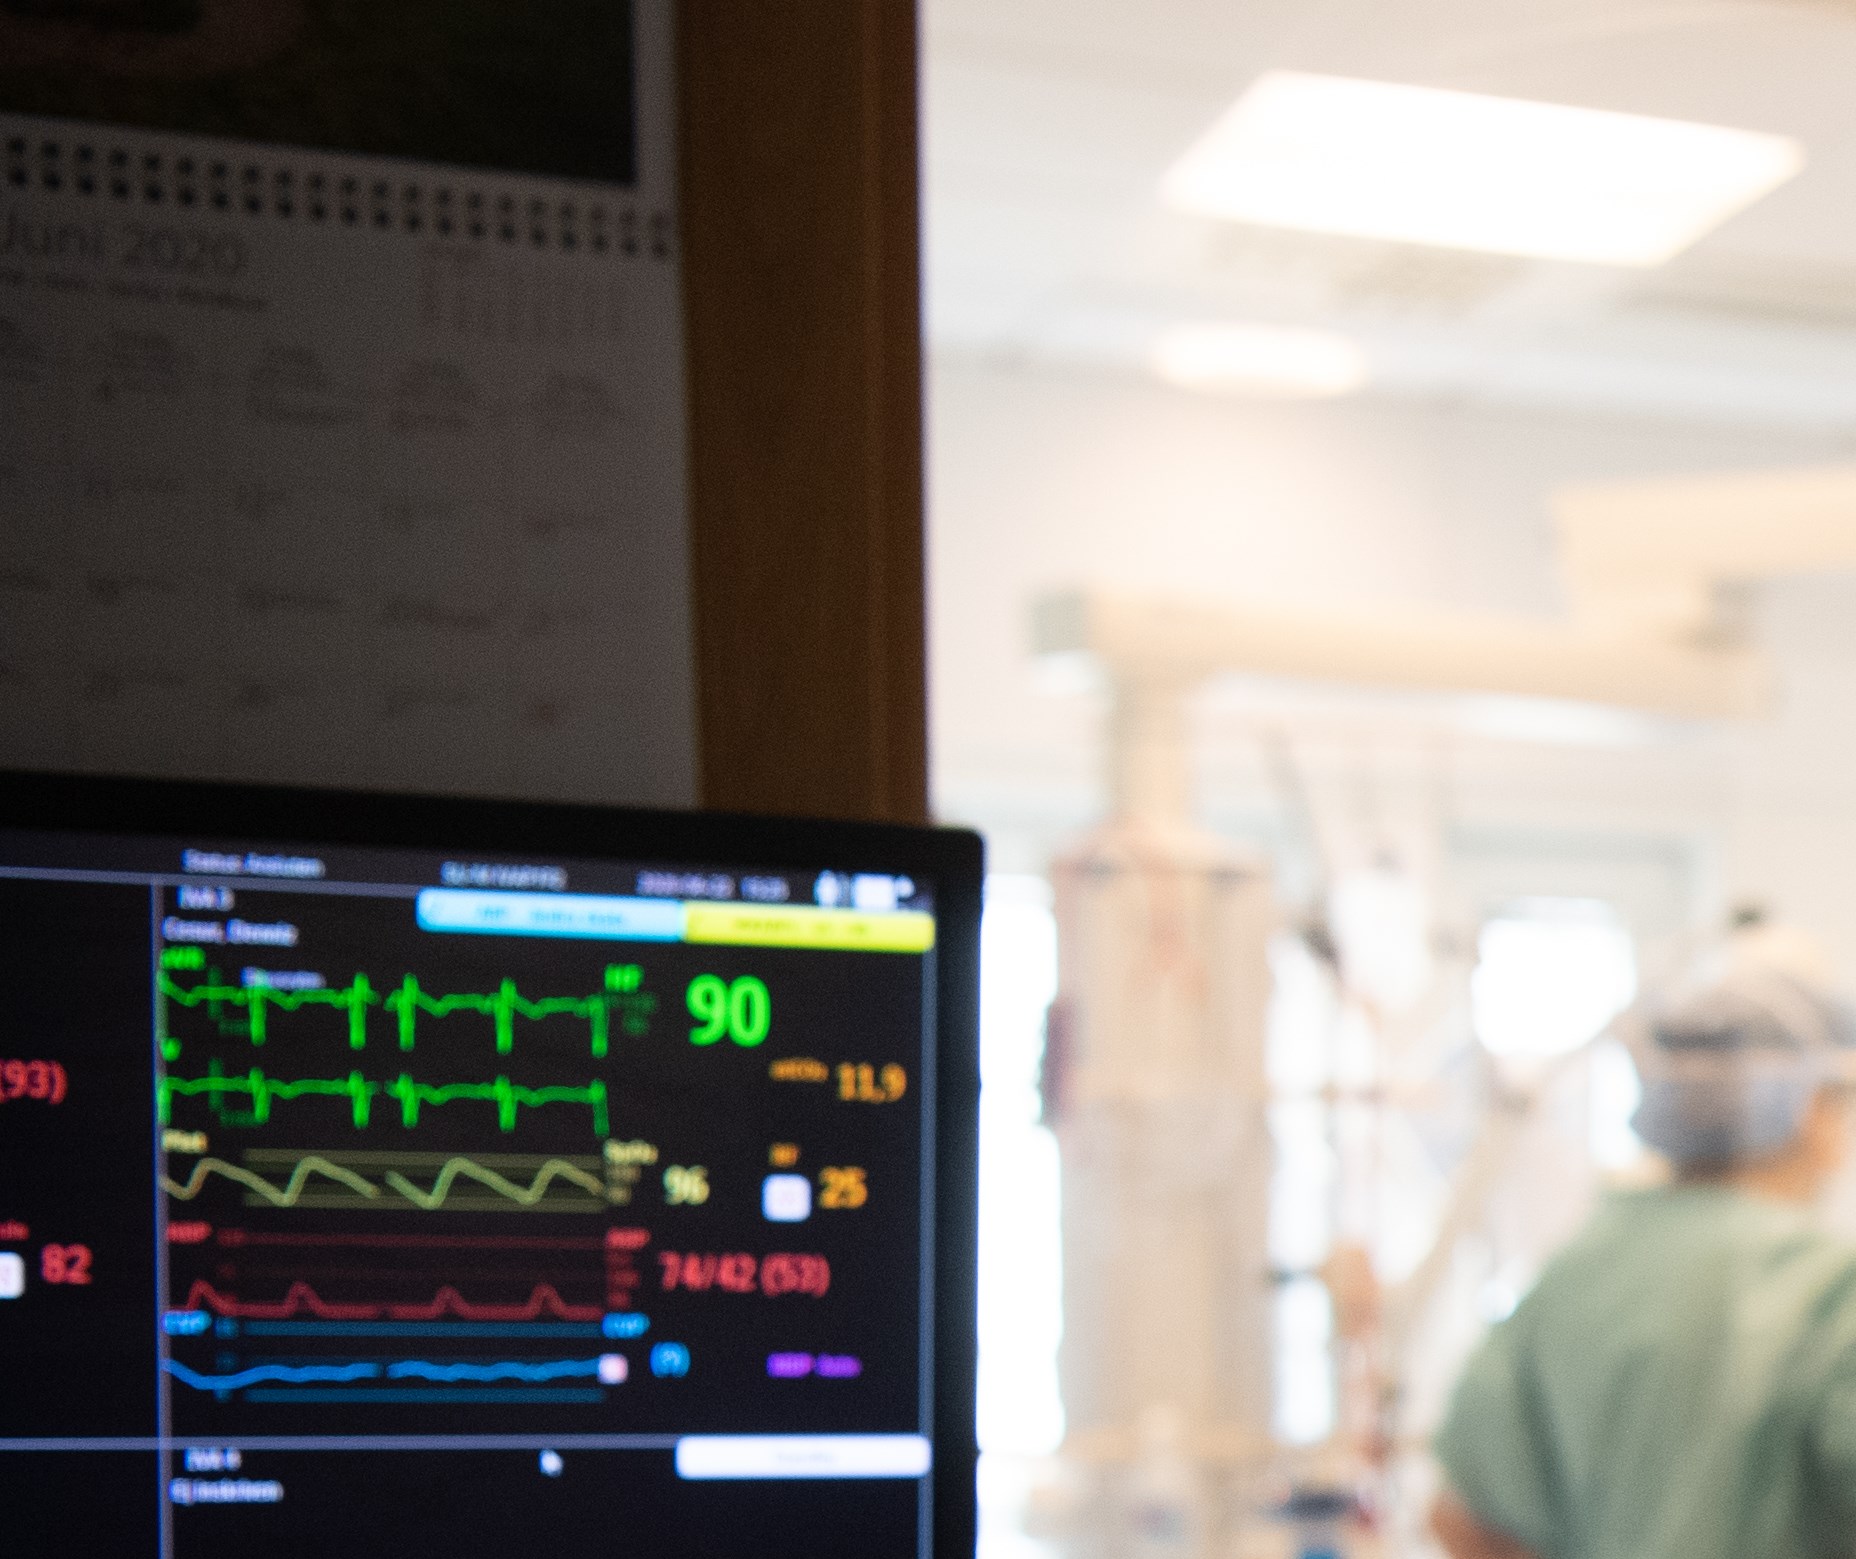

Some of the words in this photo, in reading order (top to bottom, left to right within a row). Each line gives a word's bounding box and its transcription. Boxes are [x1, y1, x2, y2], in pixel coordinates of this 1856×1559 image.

[120, 228, 250, 278] 2020
[685, 973, 771, 1047] 90
[837, 1062, 908, 1103] 11,9
[662, 1164, 711, 1205] 96
[819, 1165, 869, 1210] 25
[40, 1242, 93, 1286] 82
